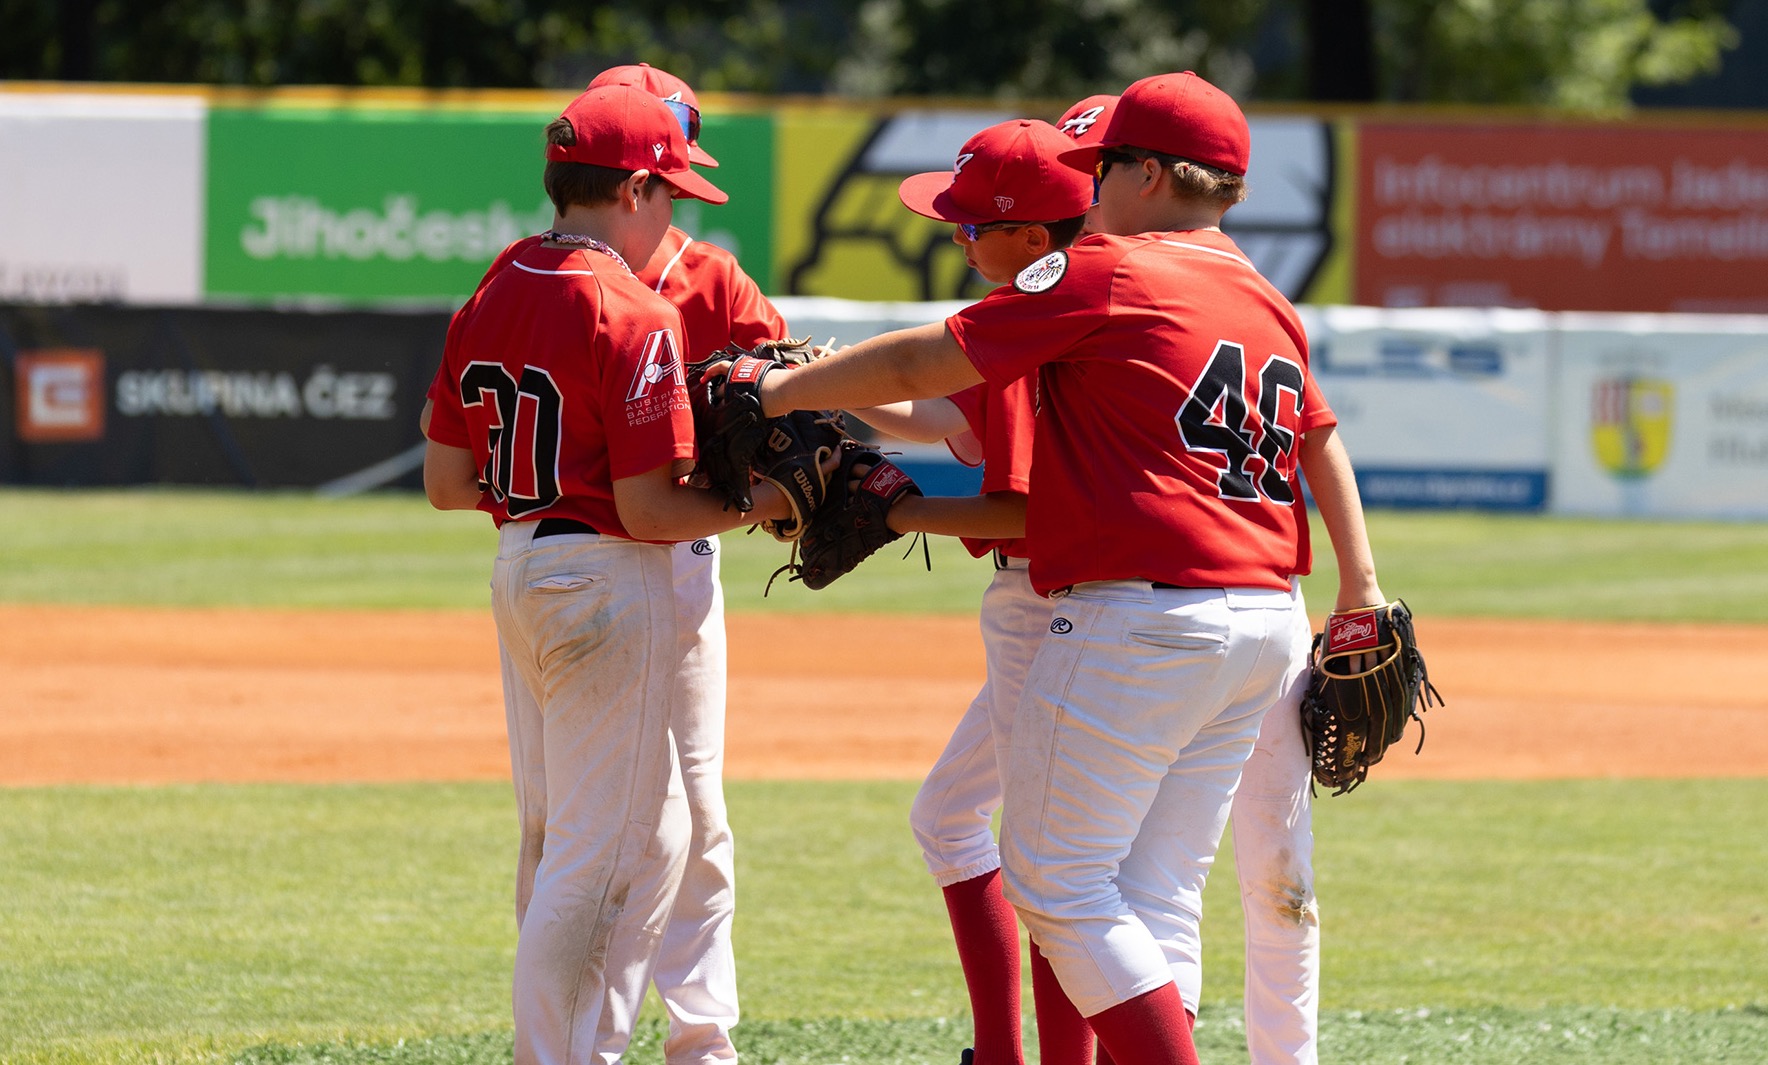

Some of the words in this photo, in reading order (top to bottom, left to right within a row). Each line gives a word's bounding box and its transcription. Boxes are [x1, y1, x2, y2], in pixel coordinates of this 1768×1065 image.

[1375, 157, 1664, 208] Infocentrum
[116, 370, 300, 418] SKUPINA
[303, 362, 397, 420] ČEZ
[625, 387, 688, 411] AUSTRIAN
[627, 396, 690, 419] BASEBALL
[628, 403, 691, 427] FEDERATION
[1174, 339, 1305, 507] 46
[460, 361, 564, 519] 30
[793, 467, 816, 512] Wilson
[1333, 622, 1371, 642] Rawlings
